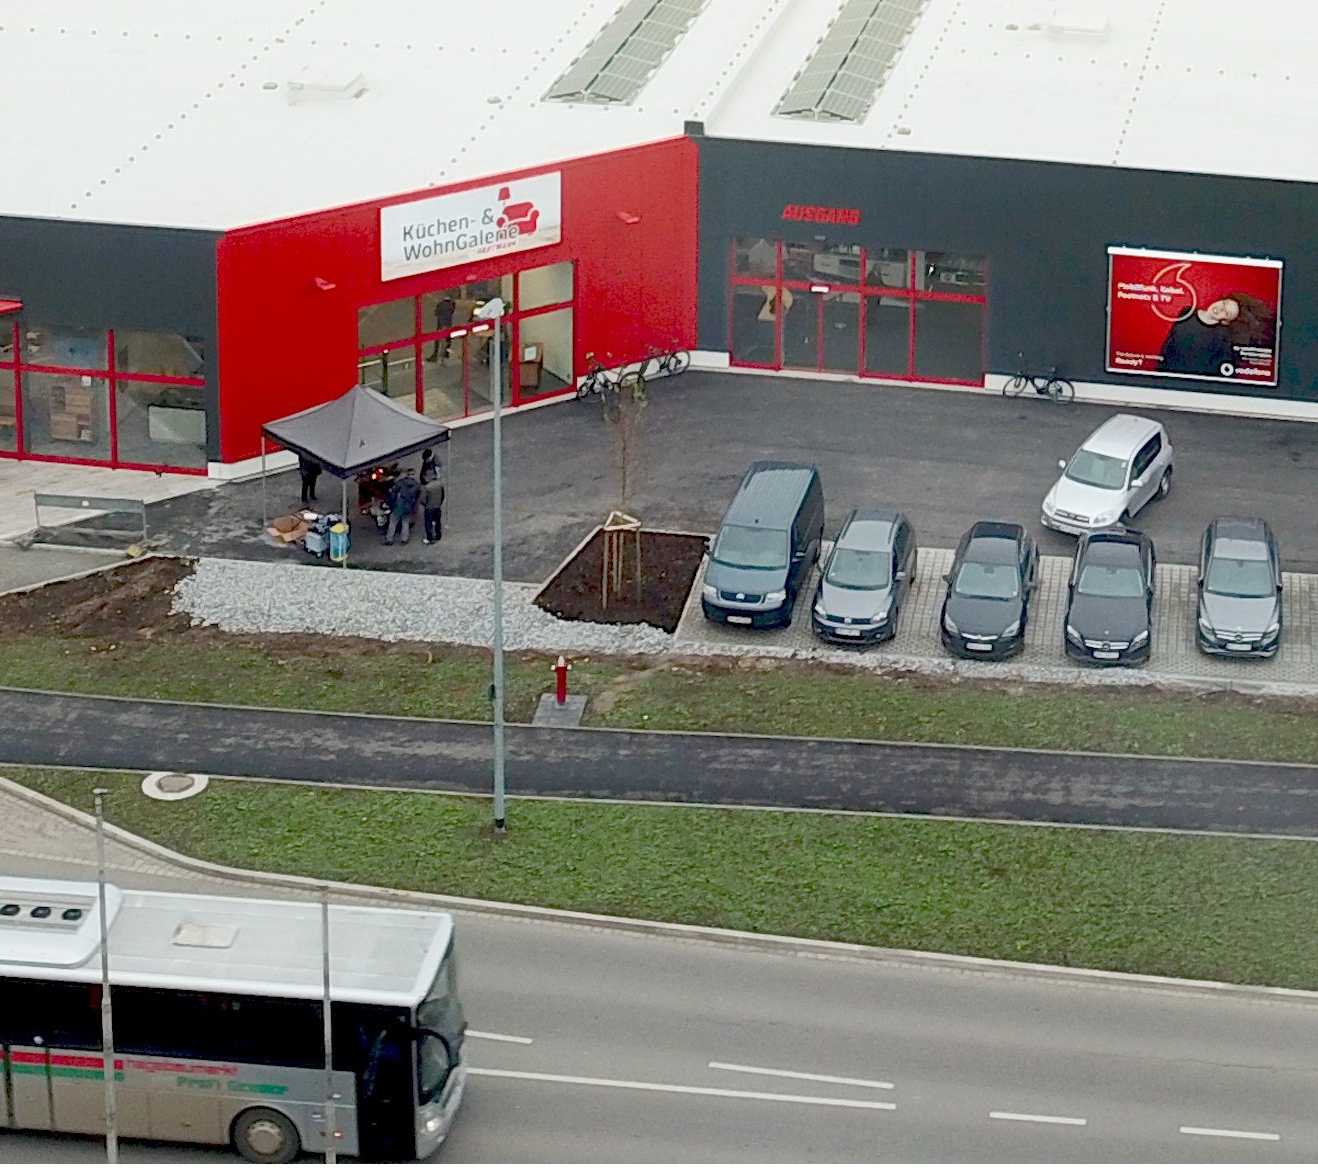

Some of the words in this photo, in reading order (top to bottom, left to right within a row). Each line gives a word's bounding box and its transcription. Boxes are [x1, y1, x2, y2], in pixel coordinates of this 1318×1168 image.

[403, 215, 476, 242] Küchen-
[482, 208, 494, 225] &
[782, 204, 861, 226] AUSGANG
